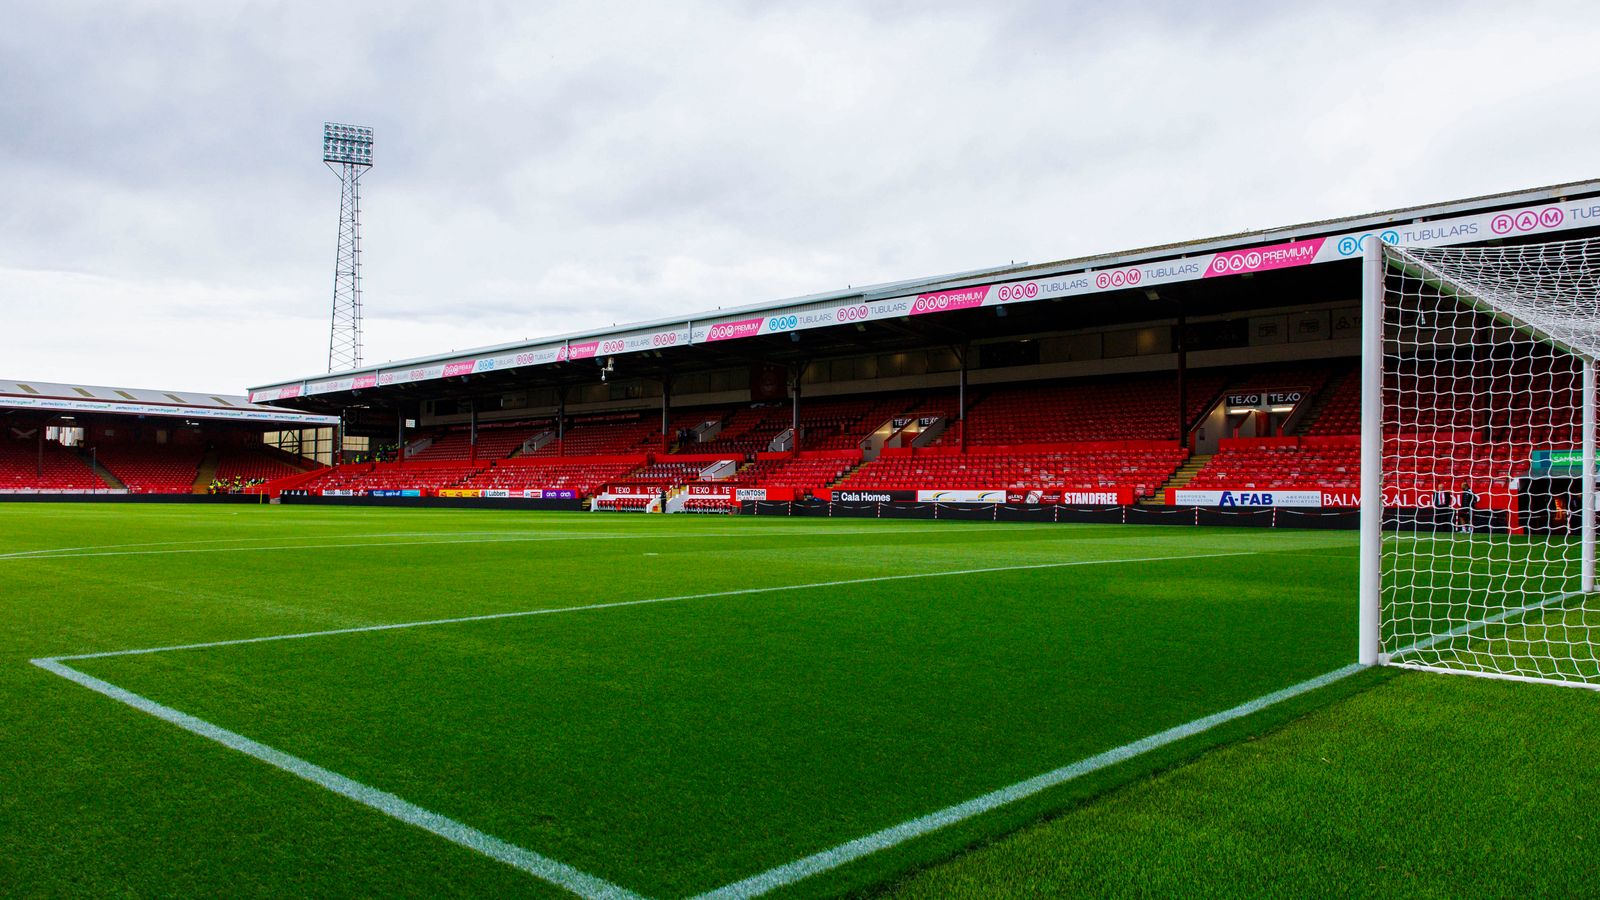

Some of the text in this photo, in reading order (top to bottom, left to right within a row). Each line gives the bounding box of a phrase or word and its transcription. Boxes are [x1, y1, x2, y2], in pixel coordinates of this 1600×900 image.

[1491, 207, 1563, 234] RAM
[1338, 223, 1478, 256] RM TUBULARS
[1212, 245, 1313, 273] RAM PREMIUM
[1096, 263, 1199, 288] RAM TUBULARS
[998, 279, 1088, 301] RAM TUBULARS
[916, 294, 948, 311] RAM
[949, 292, 982, 303] PREMIUM
[837, 303, 907, 322] RAM TUBULARS
[769, 313, 832, 331] RAM TUBULARS
[677, 331, 704, 341] TUBLARS
[711, 325, 735, 339] RAM
[1229, 395, 1259, 404] TEXO
[1270, 392, 1301, 402] TEXO
[692, 486, 710, 494] TEXO
[841, 492, 860, 501] Cala
[861, 492, 890, 501] Homes
[1064, 492, 1118, 504] STANDFREE
[1219, 491, 1273, 506] A-FAB
[1323, 494, 1411, 506] BALMRAL
